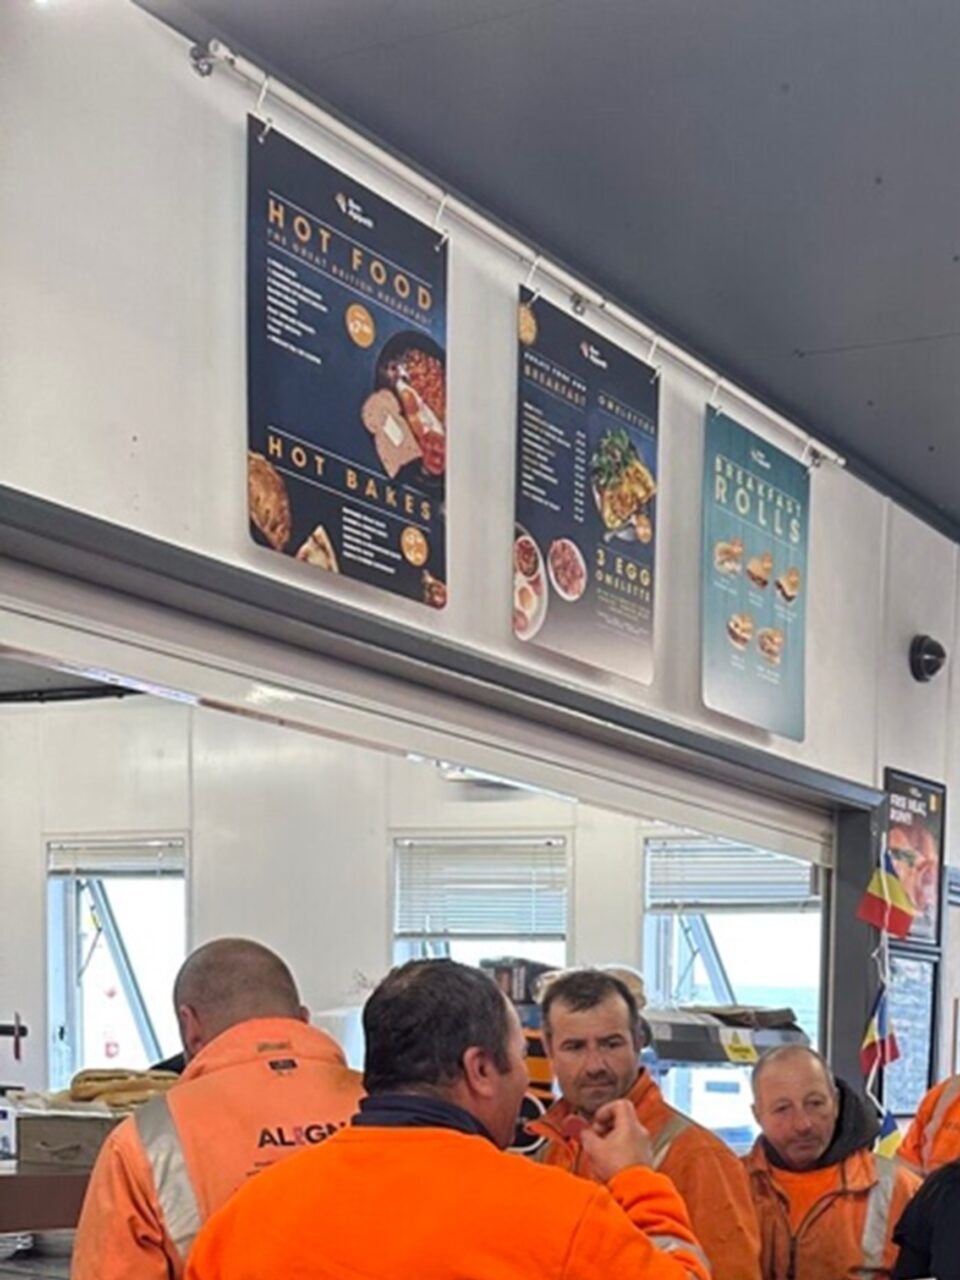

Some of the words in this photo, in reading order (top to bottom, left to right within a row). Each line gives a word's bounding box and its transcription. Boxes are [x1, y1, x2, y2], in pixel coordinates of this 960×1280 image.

[268, 199, 332, 253] HOT
[352, 248, 432, 311] FOOD
[267, 435, 325, 476] HOT
[345, 468, 431, 521] BAKES
[715, 473, 800, 543] ROLLS
[616, 556, 650, 587] EGG
